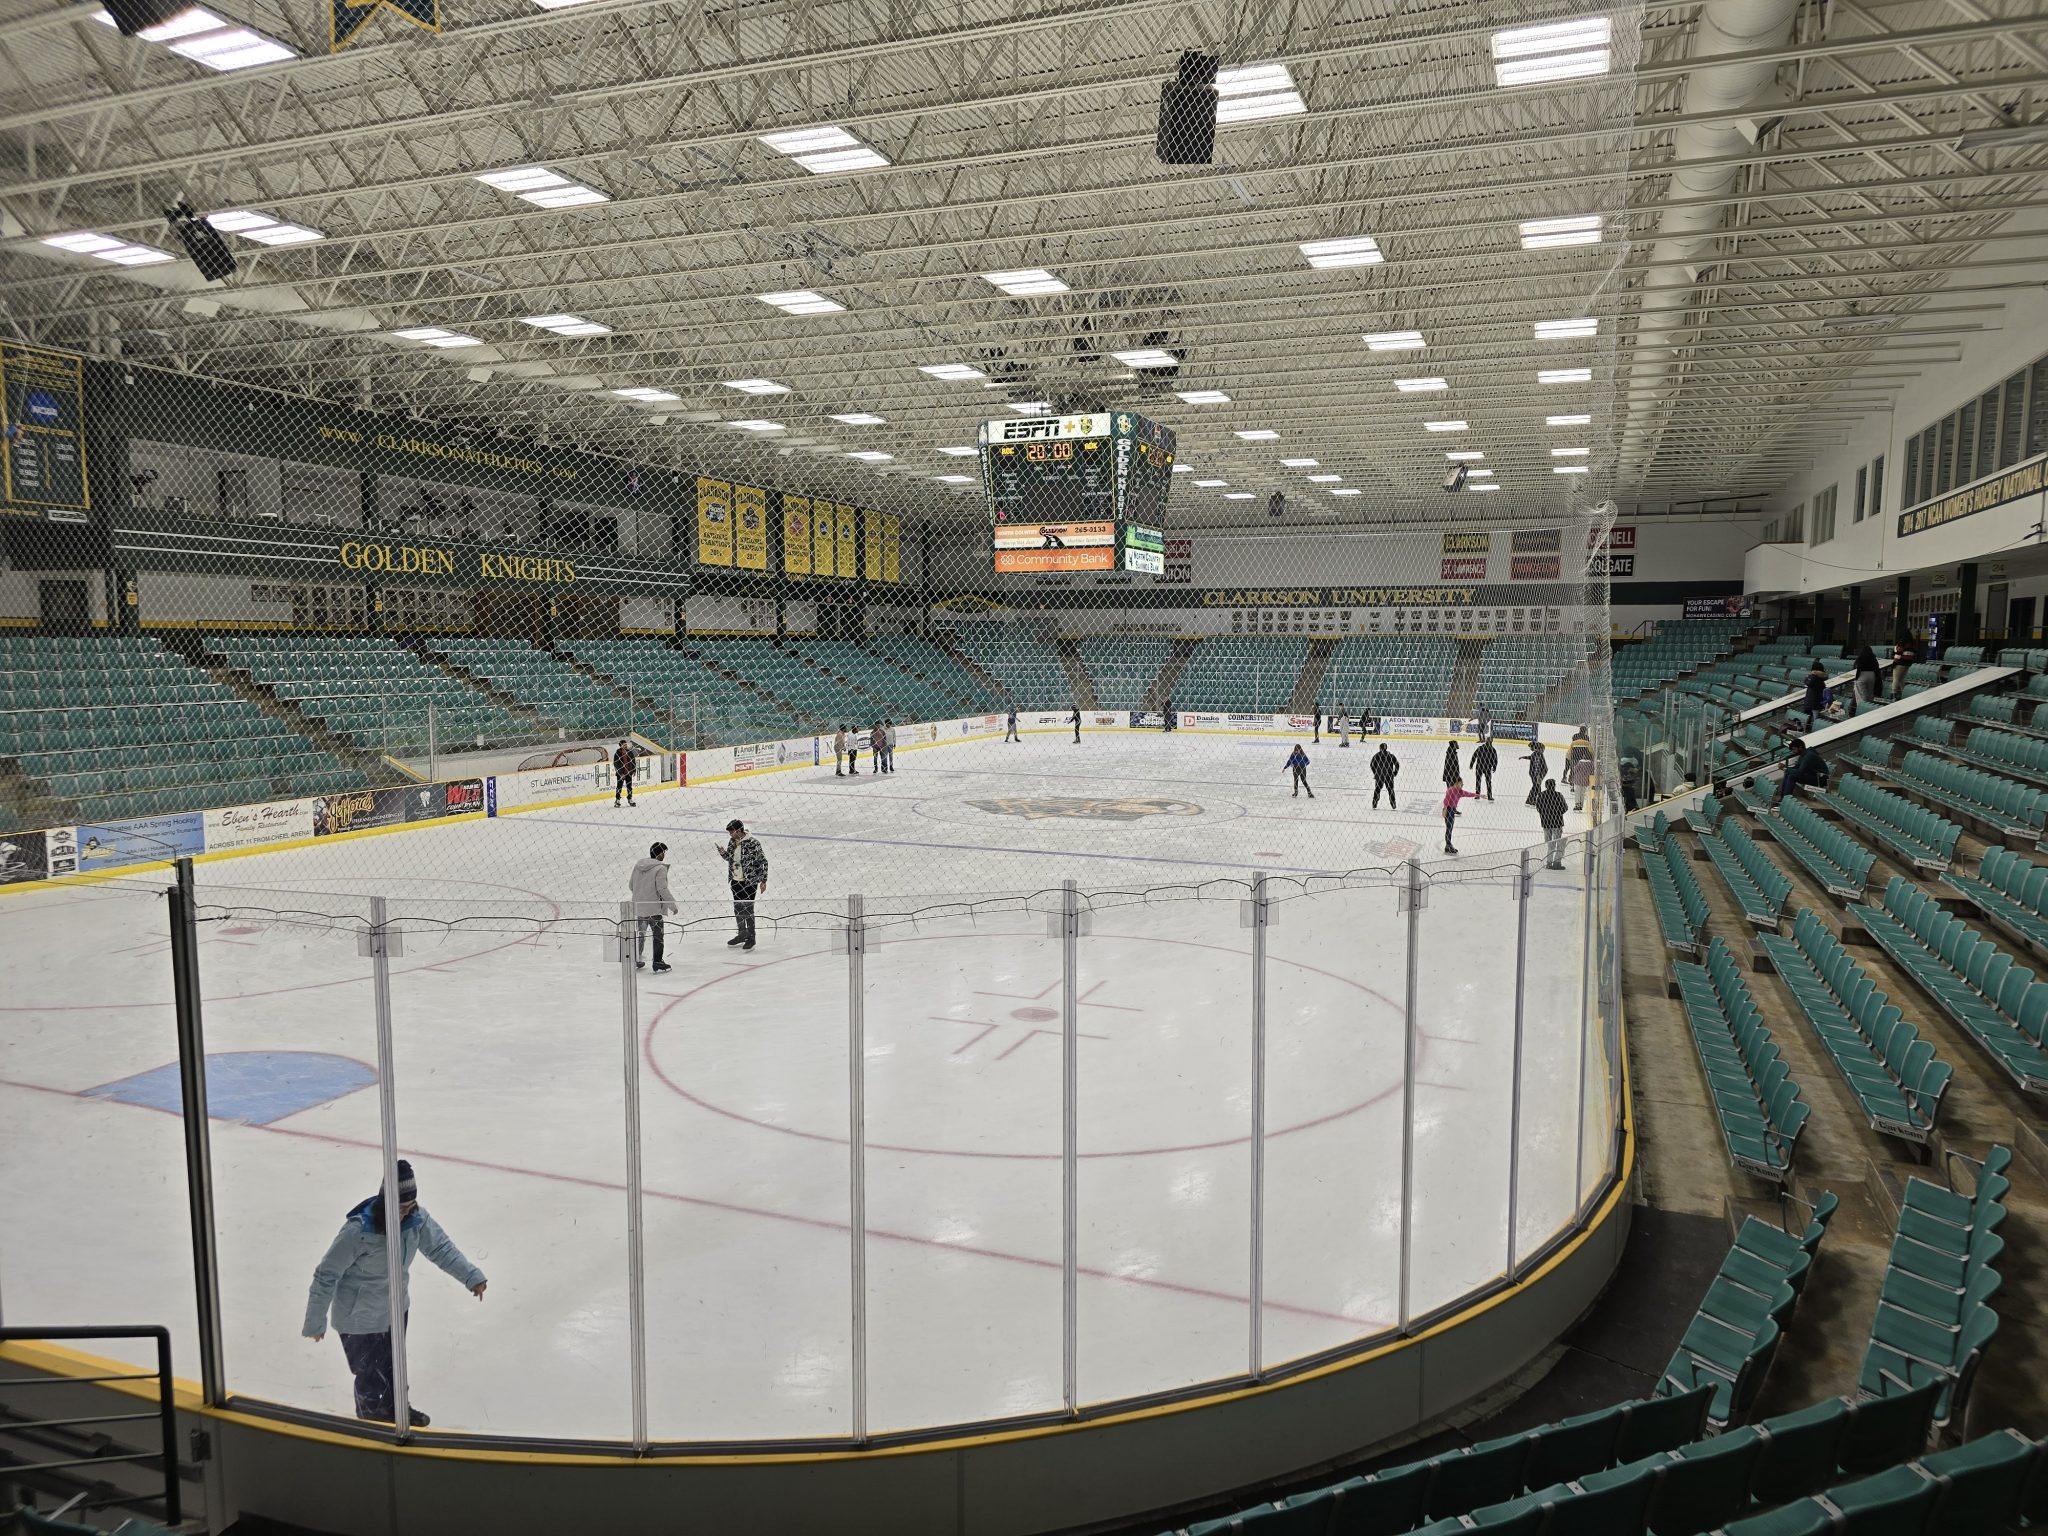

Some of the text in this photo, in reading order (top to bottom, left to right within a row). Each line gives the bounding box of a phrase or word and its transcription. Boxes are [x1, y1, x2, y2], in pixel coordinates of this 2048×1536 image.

[1003, 419, 1060, 440] ESPN
[1028, 442, 1072, 460] 20:00
[1116, 438, 1132, 477] GOLDEN
[1903, 463, 2042, 535] 2014 2017 NCAA WOMEN'S HOCKEY NATIONAL
[1445, 534, 1490, 549] CLARKSON
[1590, 531, 1633, 545] CNELL
[340, 541, 577, 583] GOLDEN KNIGHTS
[1016, 552, 1108, 566] Community Bank
[1454, 563, 1486, 575] LAWRENCE
[1203, 588, 1478, 605] CLARKSON UNIVERSITY
[1703, 598, 1725, 606] ESCAPE
[530, 771, 596, 788] ST LAWRENCE HEALTH
[150, 819, 172, 829] Spring
[173, 816, 198, 825] Hockey
[221, 808, 258, 826] Eben's
[260, 803, 299, 820] Hearth
[209, 840, 235, 850] ACROSS
[253, 836, 270, 844] FROM
[271, 832, 290, 841] CHEEL
